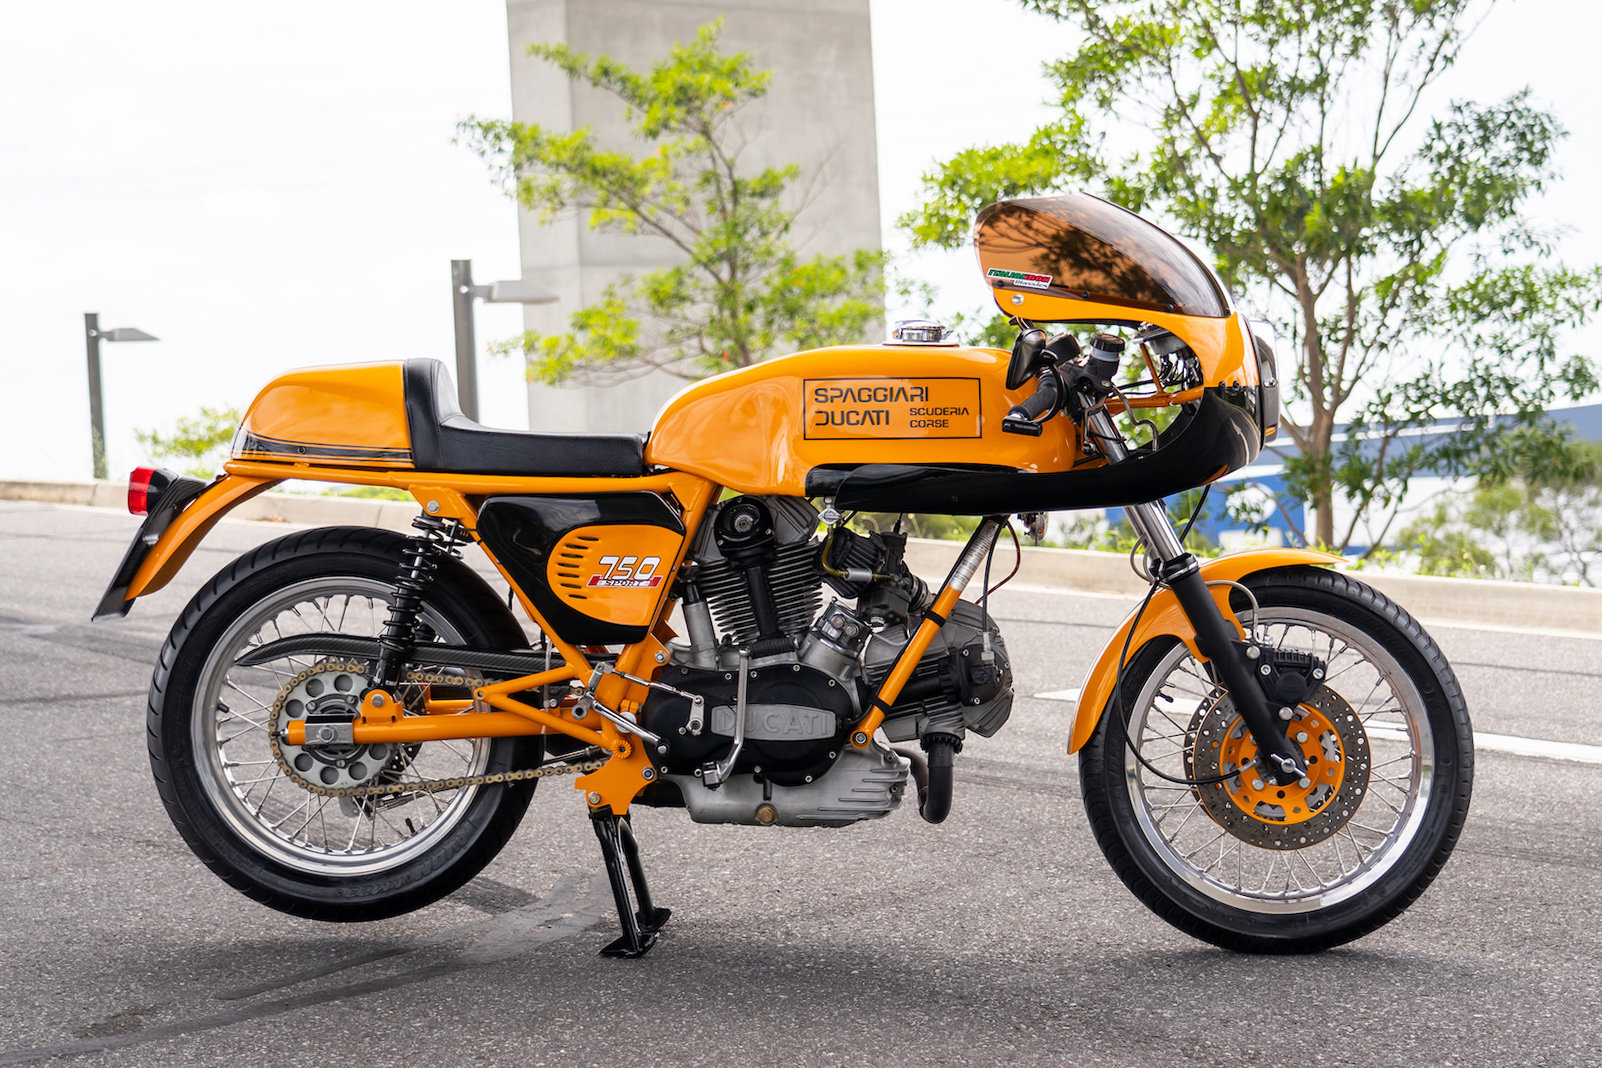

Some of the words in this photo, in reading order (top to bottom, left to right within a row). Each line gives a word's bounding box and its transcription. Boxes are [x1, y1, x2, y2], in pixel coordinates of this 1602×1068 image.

[814, 386, 929, 403] SPAGGIARI
[814, 409, 890, 426] DUCATI
[909, 407, 970, 416] SCUDERIA
[909, 419, 949, 428] CORSE
[599, 556, 661, 580] 750
[604, 579, 642, 587] SPORT
